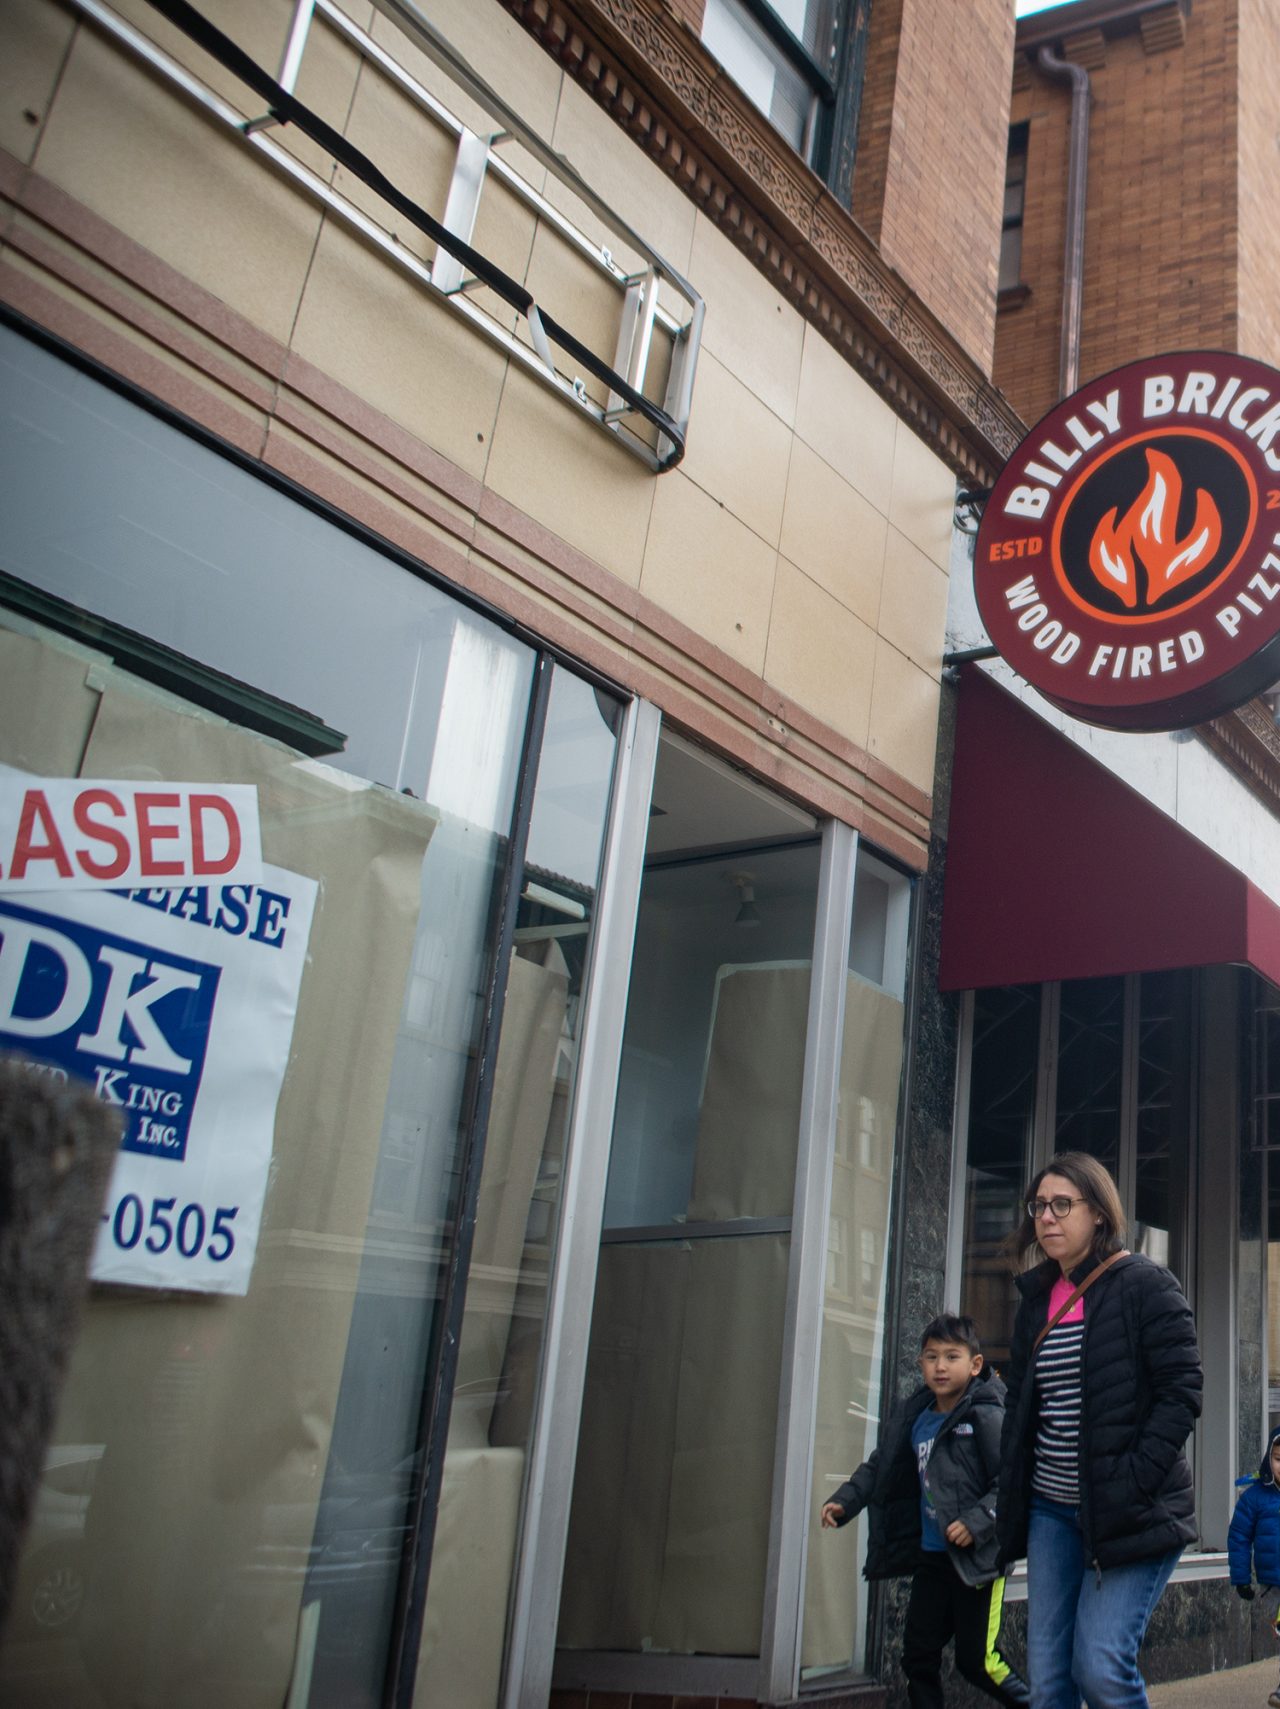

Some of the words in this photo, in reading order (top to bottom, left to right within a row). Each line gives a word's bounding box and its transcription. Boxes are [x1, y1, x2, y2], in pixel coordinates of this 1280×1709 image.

[1004, 389, 1121, 519] BILLY
[989, 536, 1043, 562] ESTD
[1004, 575, 1082, 666] WOOD
[1088, 629, 1206, 679] FIRED
[0, 787, 242, 880] ASED
[0, 913, 202, 1075] DK
